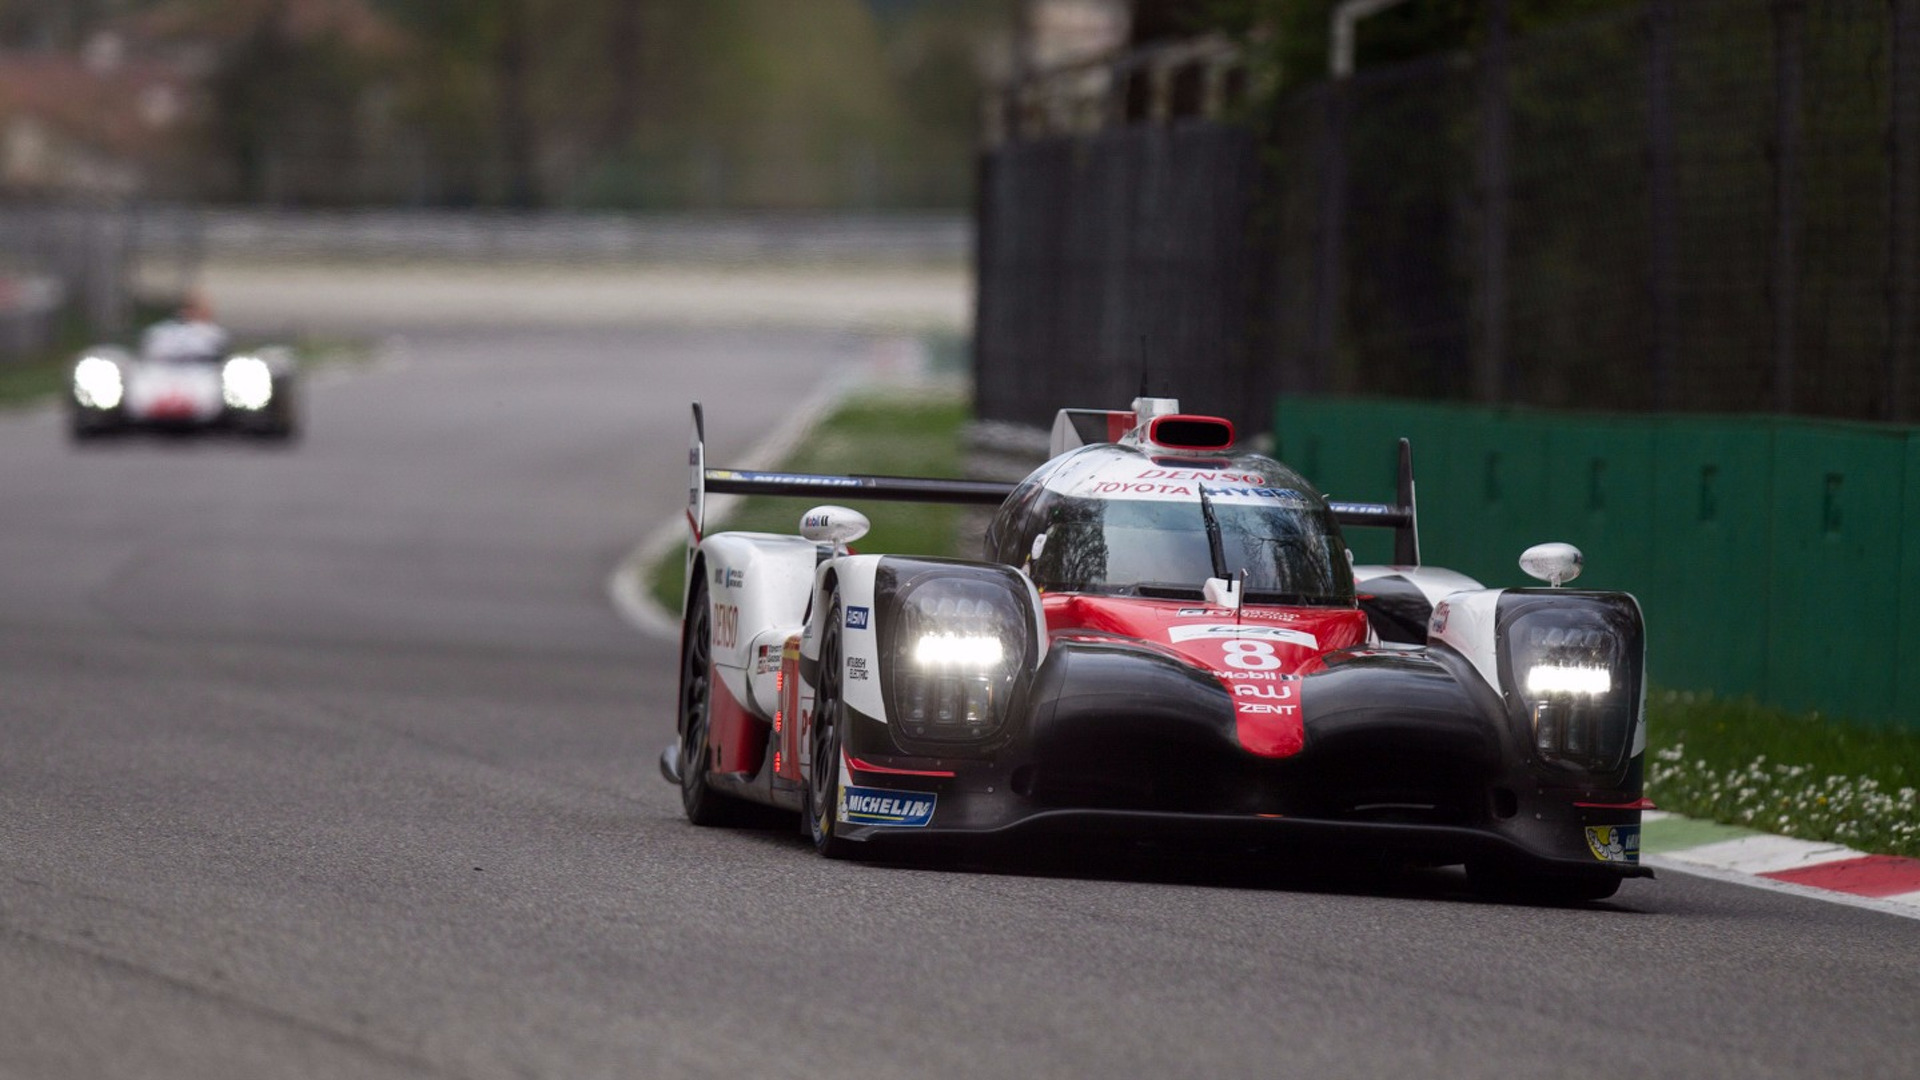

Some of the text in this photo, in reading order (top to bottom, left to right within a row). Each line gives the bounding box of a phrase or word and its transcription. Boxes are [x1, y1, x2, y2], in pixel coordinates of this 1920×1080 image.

[752, 475, 858, 487] MICHELIN
[1136, 469, 1266, 487] DENSO
[1093, 481, 1192, 497] TOYOTA
[712, 602, 739, 650] DENSO
[1221, 639, 1282, 671] 8
[1213, 670, 1277, 681] Mobil
[1238, 701, 1297, 715] ZENT
[848, 795, 932, 817] MICHELIN
